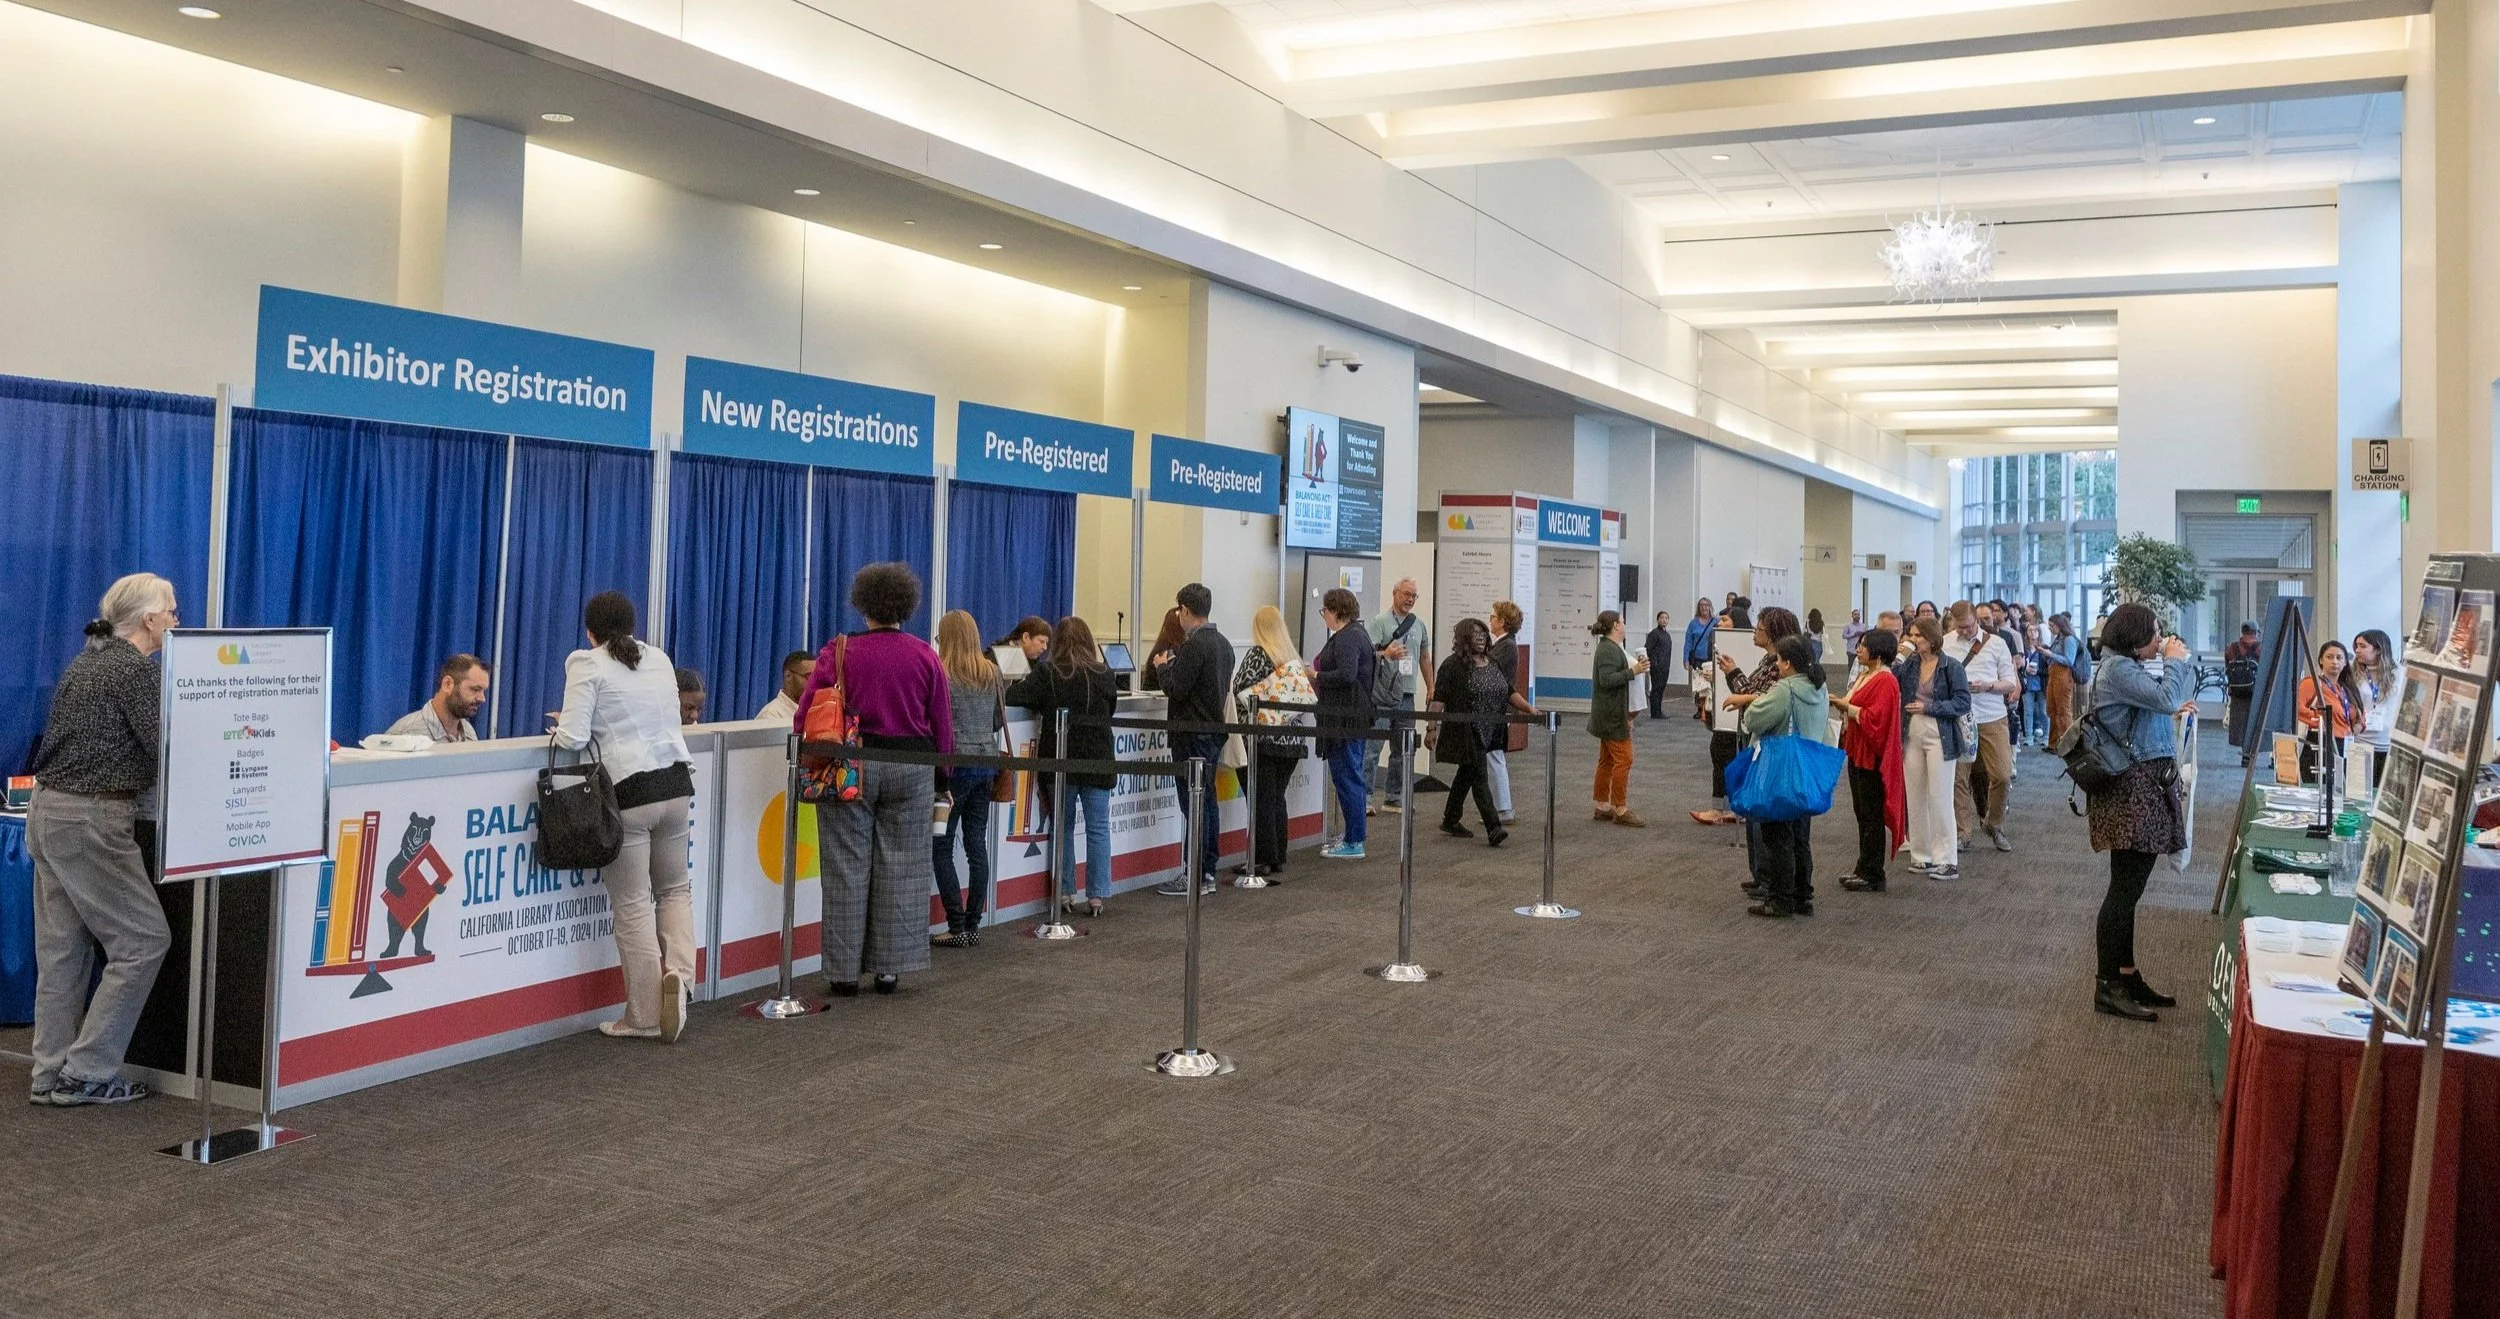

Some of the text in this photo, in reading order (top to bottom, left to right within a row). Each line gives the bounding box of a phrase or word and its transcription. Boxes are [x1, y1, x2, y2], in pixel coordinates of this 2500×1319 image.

[287, 333, 626, 412] Exhibitor Registration
[701, 388, 919, 449] New Registrations
[1346, 433, 1378, 449] Welcome and
[984, 430, 1109, 473] Pre-Registered
[1349, 448, 1374, 461] Thank You
[1346, 461, 1377, 477] for Attending
[1170, 458, 1262, 494] Pre-Registered
[2353, 474, 2405, 482] CHARGING
[1295, 490, 1321, 502] BALANCING
[2239, 499, 2259, 513] EXIT
[1548, 510, 1591, 537] WELCOME
[1823, 551, 1831, 559] A
[1874, 559, 1880, 567] B
[176, 674, 321, 688] CLA thanks the following for their
[179, 686, 319, 702] support of registration materials
[233, 712, 269, 723] Tote Bags
[237, 749, 265, 759] Badges
[241, 765, 268, 773] Lyngsoe
[241, 771, 268, 779] Systems
[232, 784, 267, 796] Lanyards
[225, 797, 247, 810] SJSU
[226, 820, 271, 832] Mobile App
[228, 834, 266, 847] CIVICA
[462, 844, 507, 907] SELF
[460, 894, 608, 940] CALIFORNIA LIBRARY ASSOCIATION
[508, 931, 544, 956] OCTOBER
[546, 928, 568, 949] 17-19,
[570, 924, 591, 945] 2024
